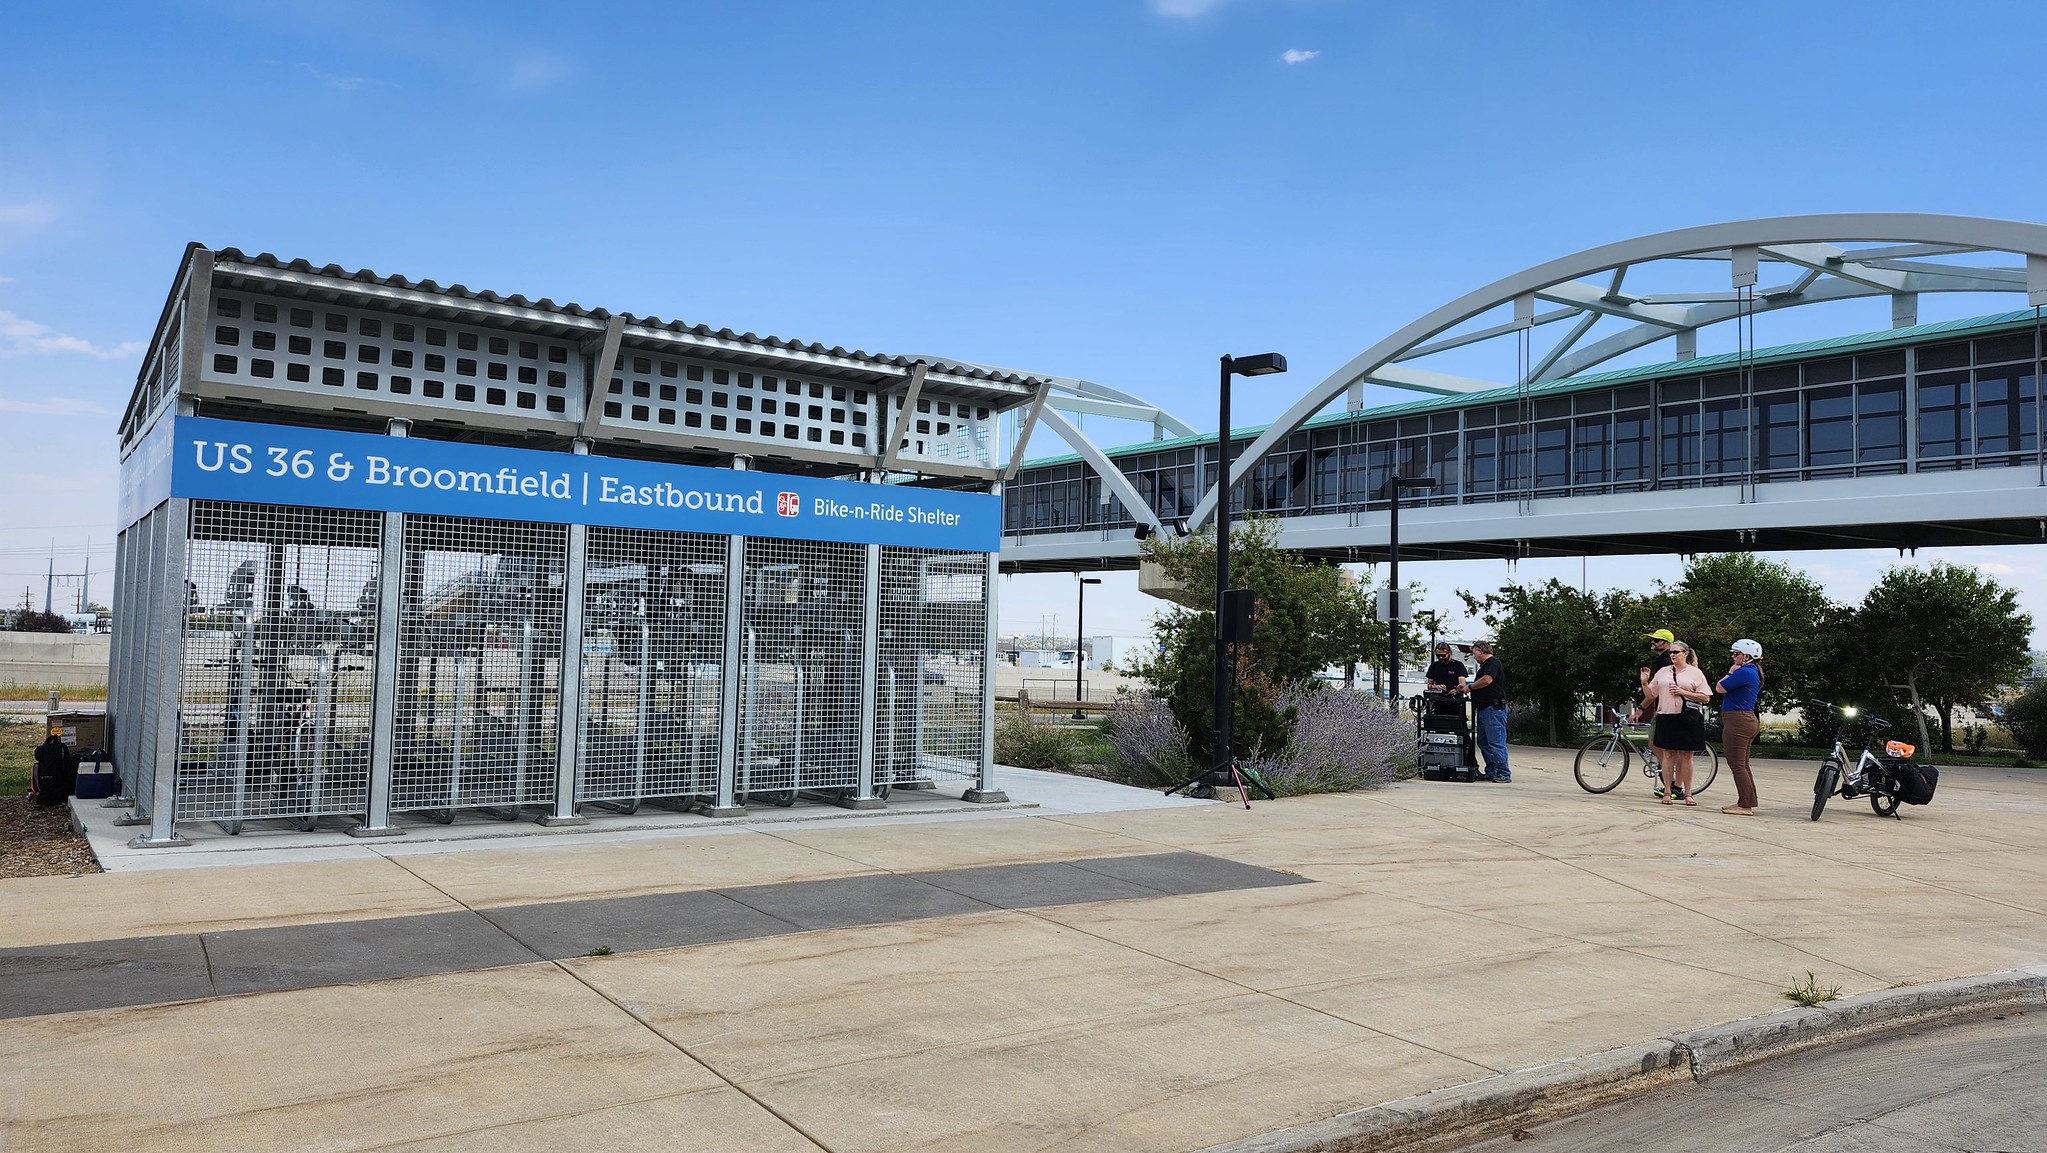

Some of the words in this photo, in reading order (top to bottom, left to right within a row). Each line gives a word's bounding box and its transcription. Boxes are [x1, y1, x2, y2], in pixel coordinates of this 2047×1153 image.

[193, 440, 252, 474] US
[266, 446, 315, 479] 36
[327, 452, 354, 482] &
[365, 455, 572, 499] Broomfield
[599, 476, 764, 514] Eastbound
[814, 498, 904, 522] Bike-n-Ride
[907, 506, 961, 526] Shelter
